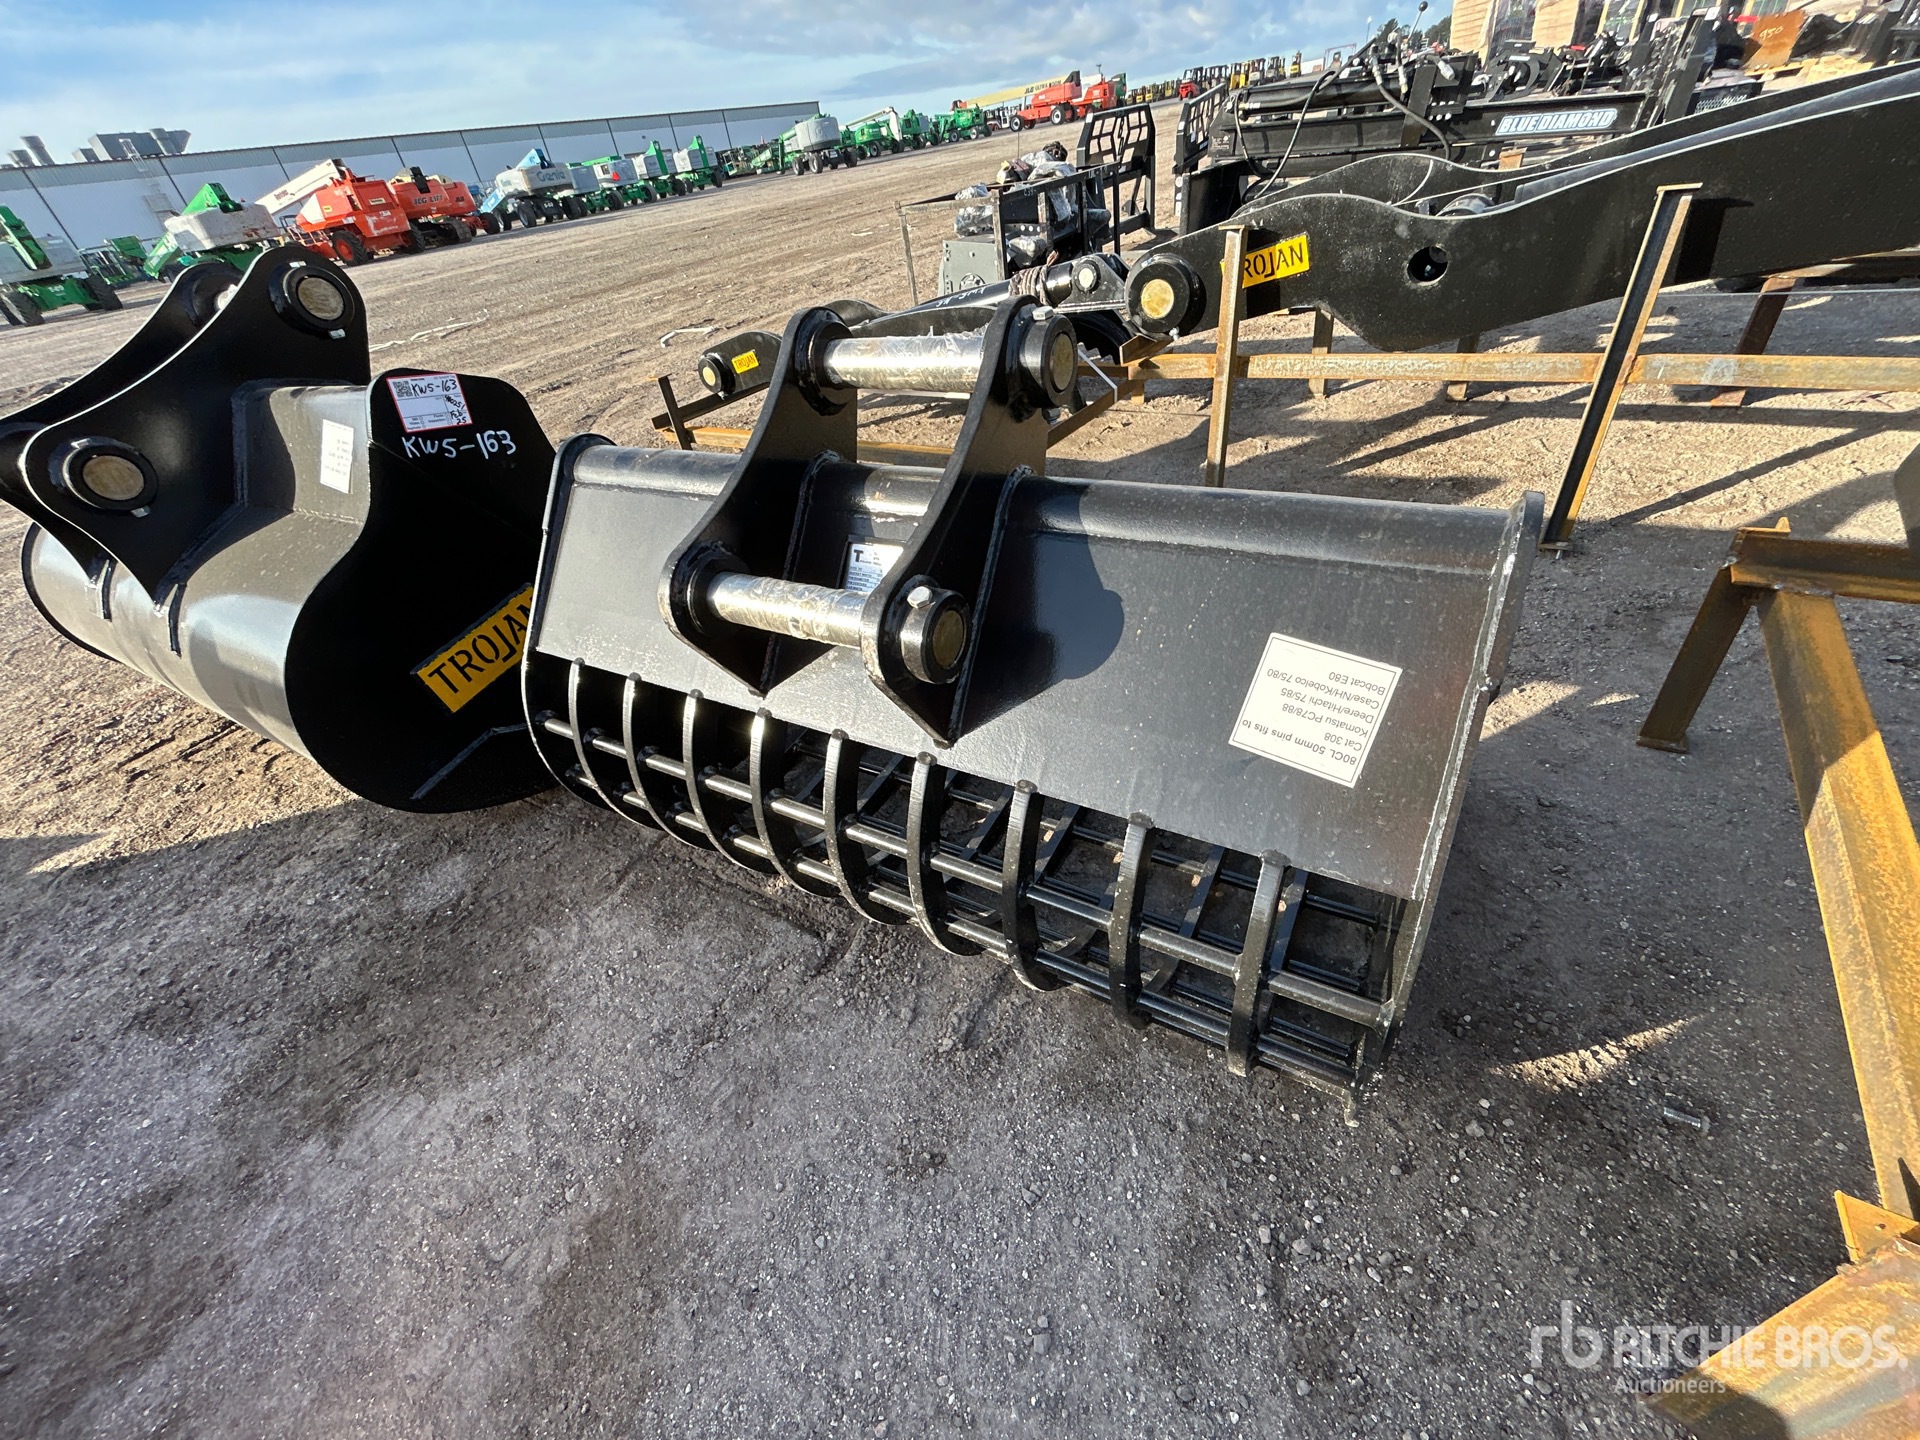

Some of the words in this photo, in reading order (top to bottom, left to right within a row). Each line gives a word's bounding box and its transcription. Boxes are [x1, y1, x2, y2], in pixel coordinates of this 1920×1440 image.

[1759, 26, 1784, 40] 950
[1499, 116, 1540, 133] BLUE
[1536, 110, 1616, 131] DIAMOND
[536, 170, 566, 182] Genie
[1244, 242, 1304, 278] ROJAN
[734, 354, 757, 370] TROJAN
[411, 379, 457, 397] KW5-163
[457, 416, 467, 425] 25
[402, 430, 517, 459] KW5-163
[1267, 668, 1293, 683] 75/80
[1329, 671, 1349, 685] E80
[1280, 687, 1306, 703] 75/85
[1295, 676, 1380, 710] Case/NH/Kobelco
[1351, 680, 1386, 696] Bobcat
[1282, 703, 1323, 723] PC78/88
[1309, 697, 1374, 724] Deere/Hitachi
[1242, 719, 1252, 729] to
[1253, 722, 1268, 736] fits
[1325, 715, 1369, 738] Komatsu
[1271, 729, 1293, 742] pins
[1324, 732, 1343, 745] 308
[1295, 736, 1326, 755] 50mm
[1346, 740, 1362, 752] Cat
[1329, 748, 1357, 766] 80CL
